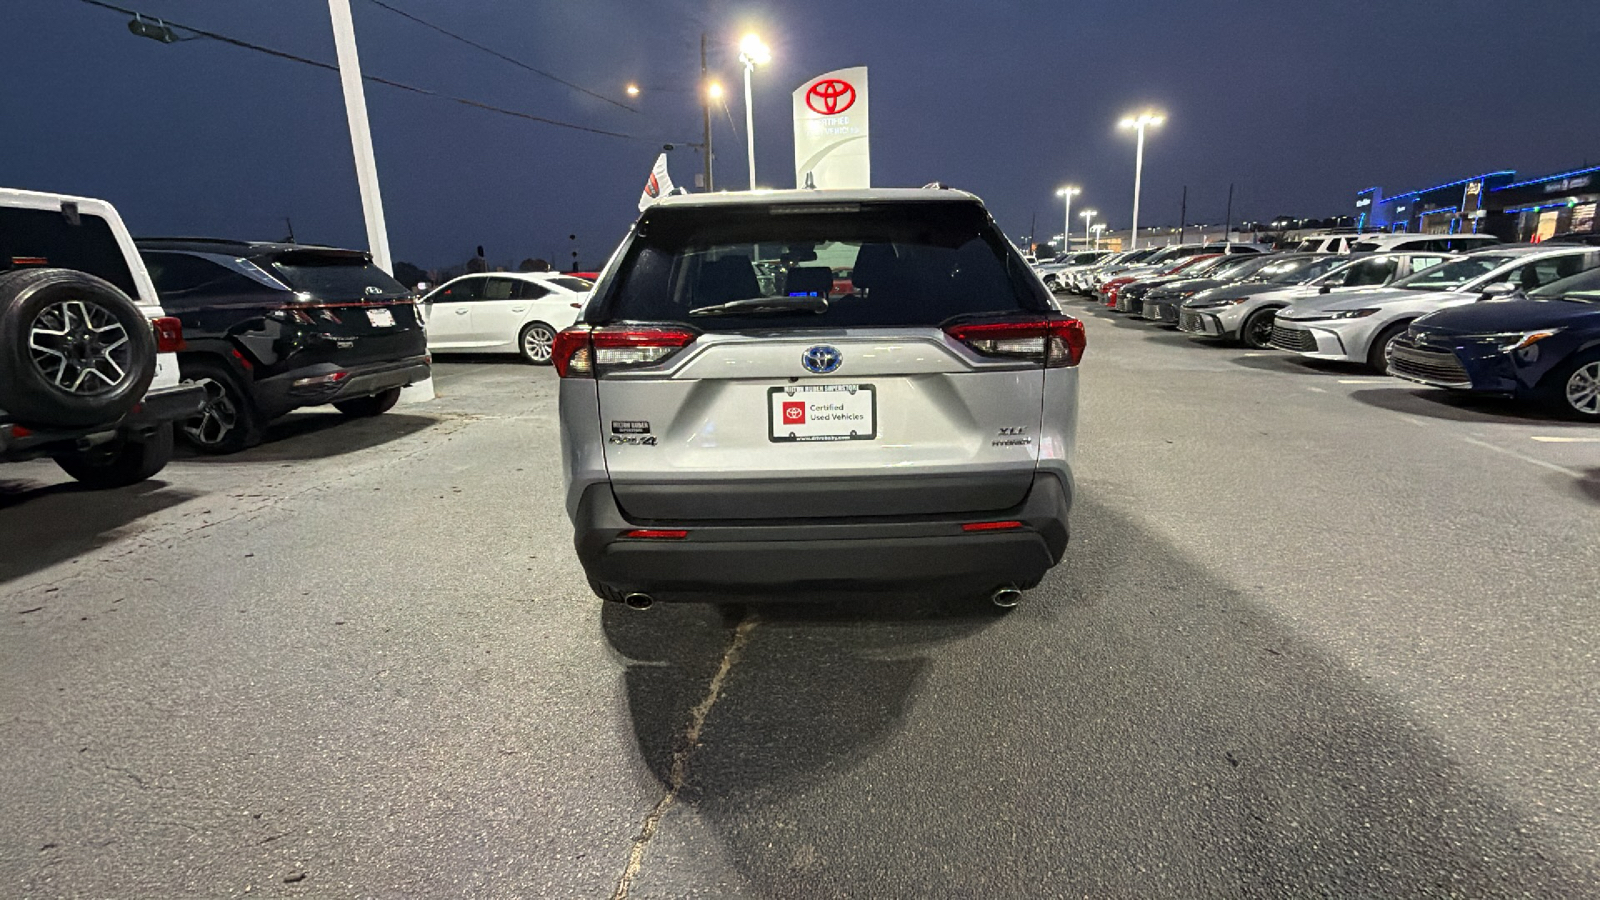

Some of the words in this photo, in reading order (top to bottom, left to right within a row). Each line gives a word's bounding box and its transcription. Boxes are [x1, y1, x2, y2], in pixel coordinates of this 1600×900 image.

[810, 403, 844, 411] Certified
[832, 412, 864, 421] Vehicles
[998, 426, 1027, 436] XLE
